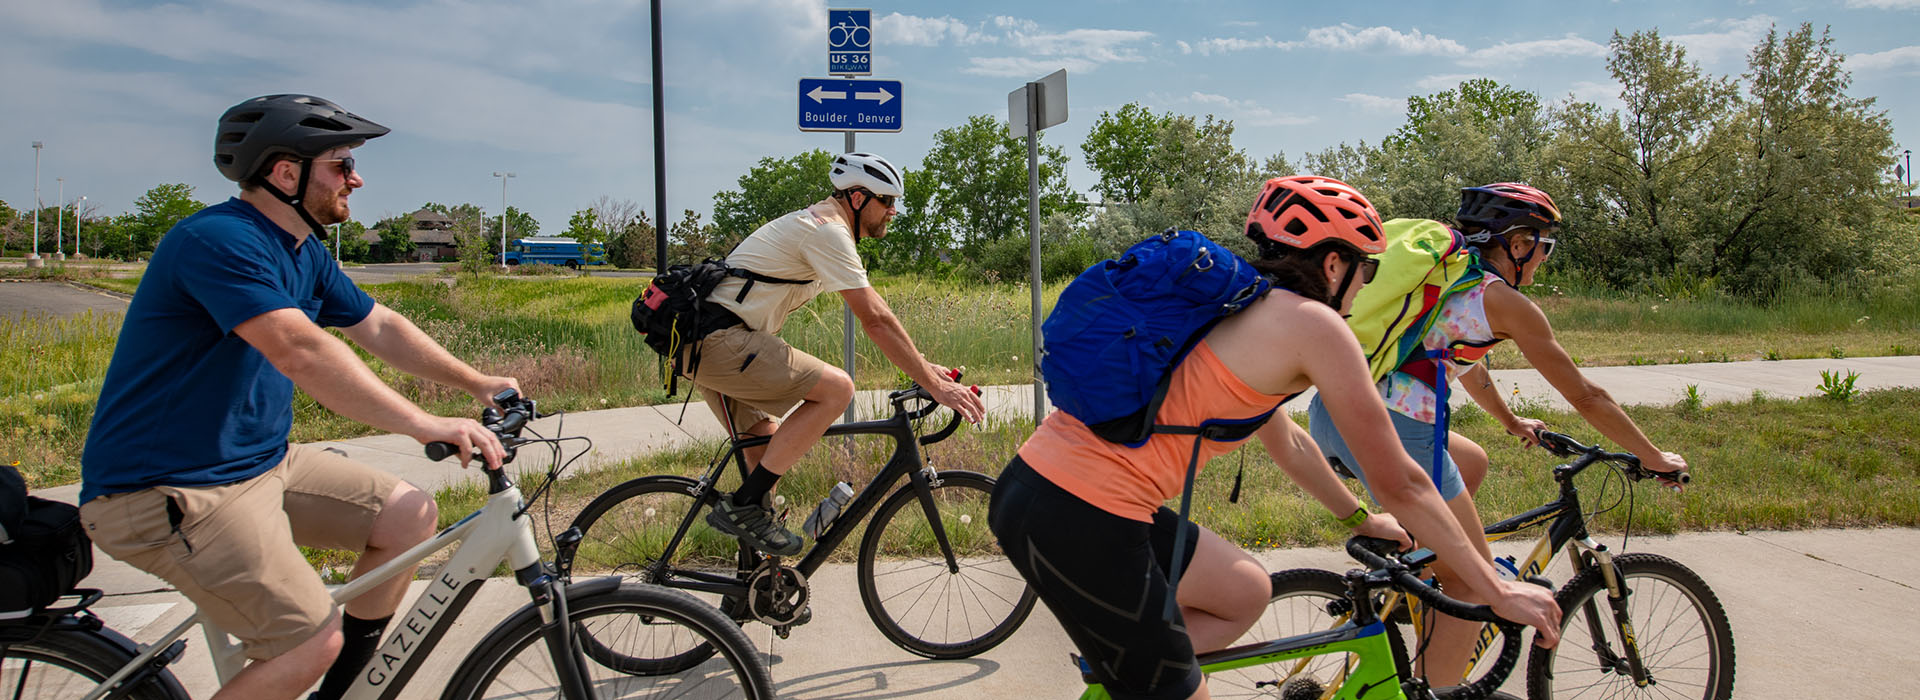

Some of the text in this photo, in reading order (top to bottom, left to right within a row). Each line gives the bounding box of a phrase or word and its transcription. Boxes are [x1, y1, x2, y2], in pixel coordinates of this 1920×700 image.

[831, 55, 868, 63] US 36
[805, 111, 847, 122] Boulder
[858, 112, 895, 123] Denver
[367, 573, 460, 686] GAZELLE
